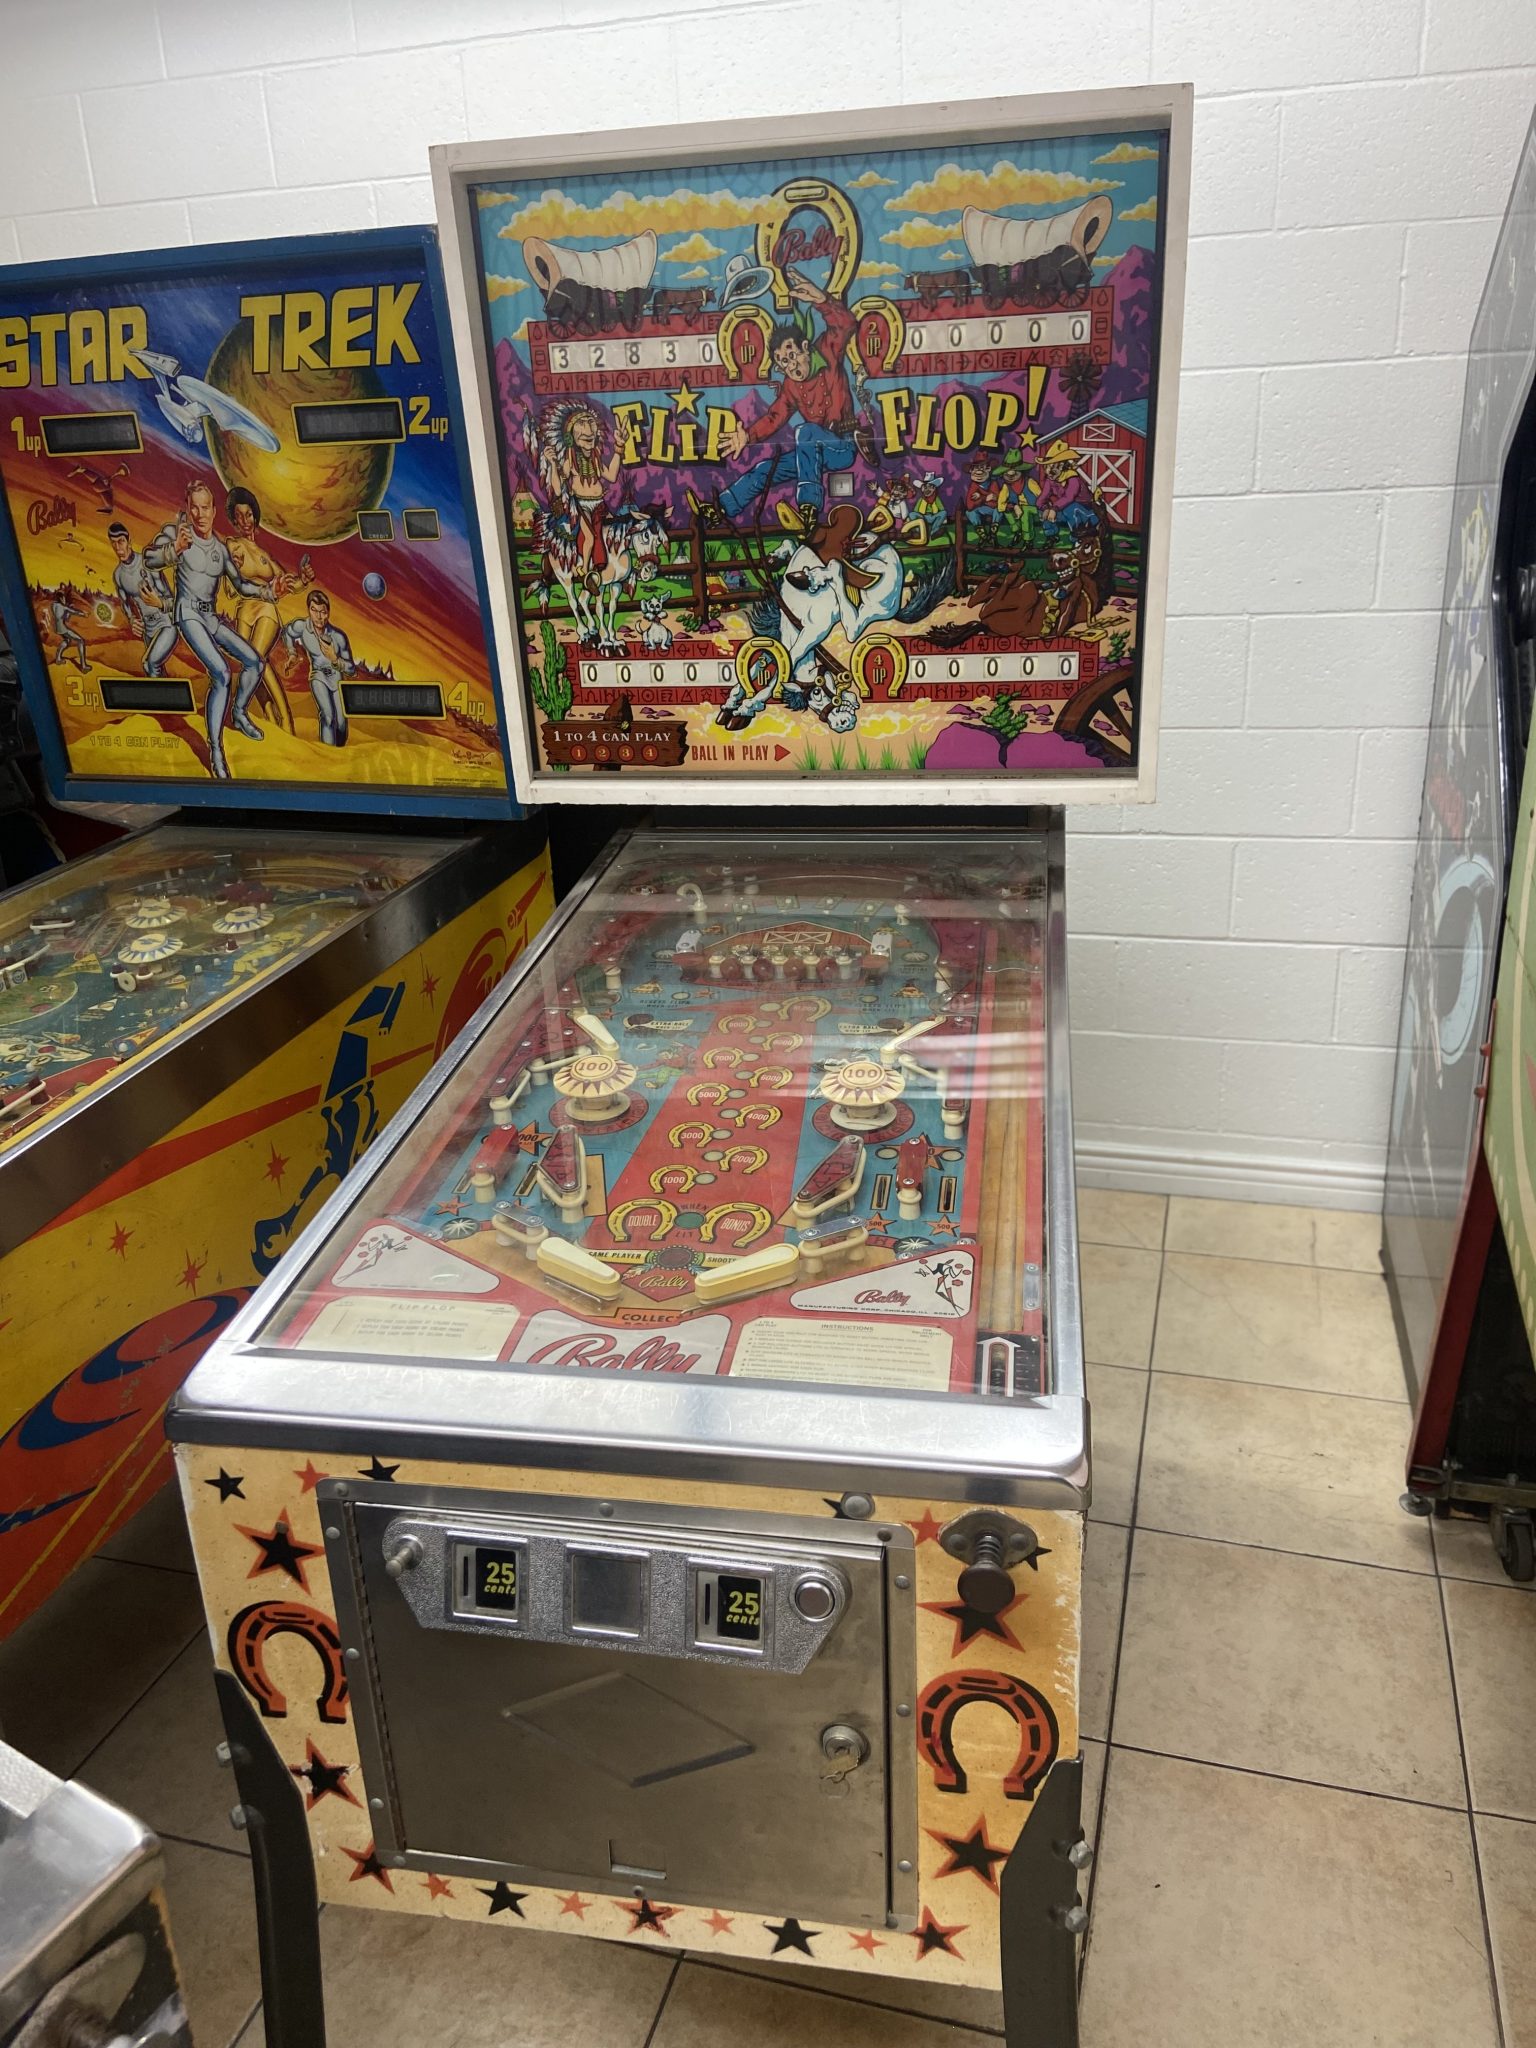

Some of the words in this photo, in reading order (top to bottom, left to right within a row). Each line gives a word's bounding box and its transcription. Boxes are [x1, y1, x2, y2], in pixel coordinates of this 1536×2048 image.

[772, 225, 844, 268] Bally
[0, 304, 154, 388] STAR
[240, 282, 422, 374] TREK
[868, 321, 878, 335] 2
[740, 344, 755, 363] UP
[866, 337, 881, 357] UP
[876, 364, 1048, 456] FLOP!
[27, 494, 78, 535] Bally
[758, 656, 767, 668] 3
[873, 655, 883, 666] 4
[757, 671, 771, 686] UP
[872, 667, 887, 684] UP
[554, 730, 561, 742] 1
[564, 732, 583, 742] TO
[587, 730, 598, 742] 4
[602, 732, 630, 742] CAN
[635, 732, 671, 742] PLAY
[691, 745, 718, 761] BALL
[723, 745, 735, 761] IN
[742, 745, 769, 761] PLAY
[578, 1062, 609, 1072] 100
[847, 1069, 878, 1079] 100
[747, 1113, 770, 1121] 4000
[680, 1132, 704, 1140] 3000
[732, 1154, 755, 1164] 2000
[663, 1176, 686, 1184] 1000
[627, 1214, 659, 1227] DOUBLE
[720, 1217, 751, 1232] BONUS
[675, 1231, 694, 1239] LIT
[588, 1251, 609, 1259] SAME
[611, 1252, 642, 1260] PLAYER
[638, 1275, 690, 1290] Bally
[853, 1289, 912, 1307] Bally
[821, 1323, 875, 1332] INSTRUCTIONS
[527, 1333, 702, 1373] Bally
[486, 1561, 515, 1585] 25
[484, 1584, 517, 1595] cents
[729, 1590, 759, 1616] 25
[726, 1614, 761, 1626] cents
